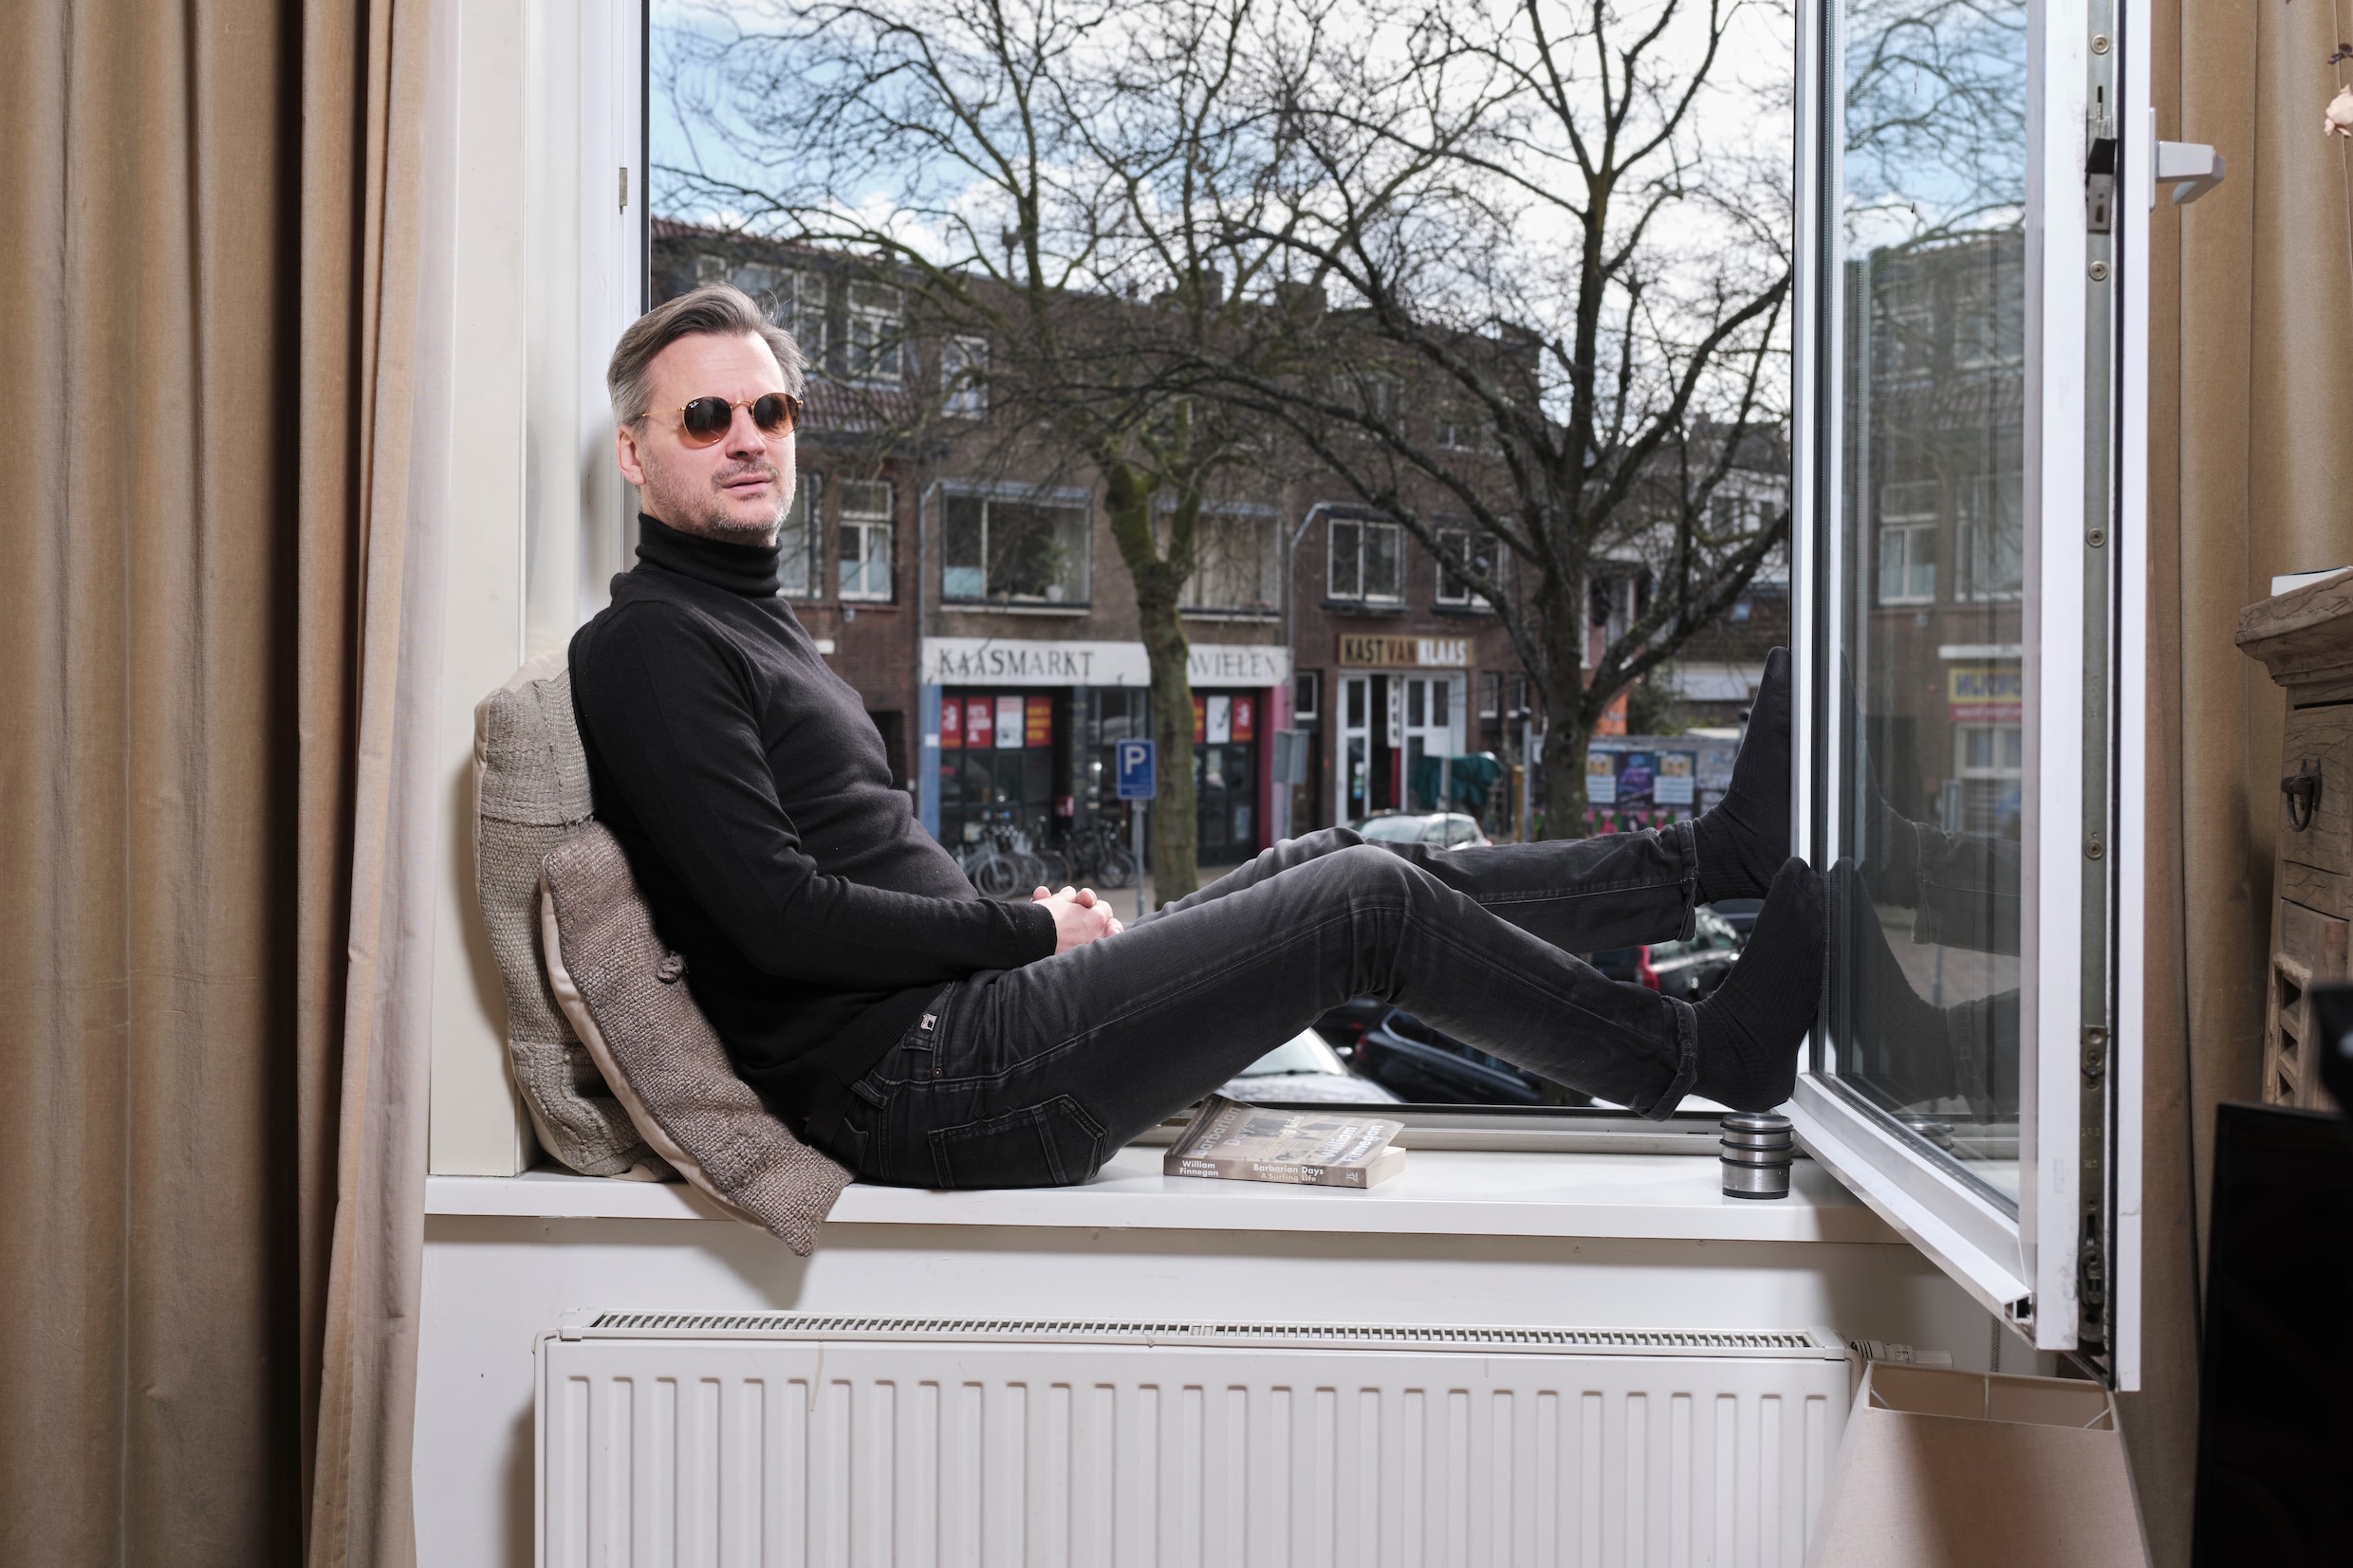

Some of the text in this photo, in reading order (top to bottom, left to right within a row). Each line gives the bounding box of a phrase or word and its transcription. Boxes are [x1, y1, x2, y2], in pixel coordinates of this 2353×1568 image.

[938, 648, 1095, 677] KAASMARKT
[1345, 638, 1466, 666] KAST VAN KLAAS
[1124, 746, 1146, 776] P
[1190, 1106, 1242, 1156] Barbarian
[1223, 1123, 1255, 1146] Days
[1319, 1125, 1359, 1157] William
[1342, 1124, 1383, 1162] Finnegan
[1179, 1168, 1219, 1177] Finnegan
[1181, 1160, 1215, 1169] William
[1253, 1164, 1324, 1175] Barbarian Days
[1269, 1172, 1298, 1182] Surfing
